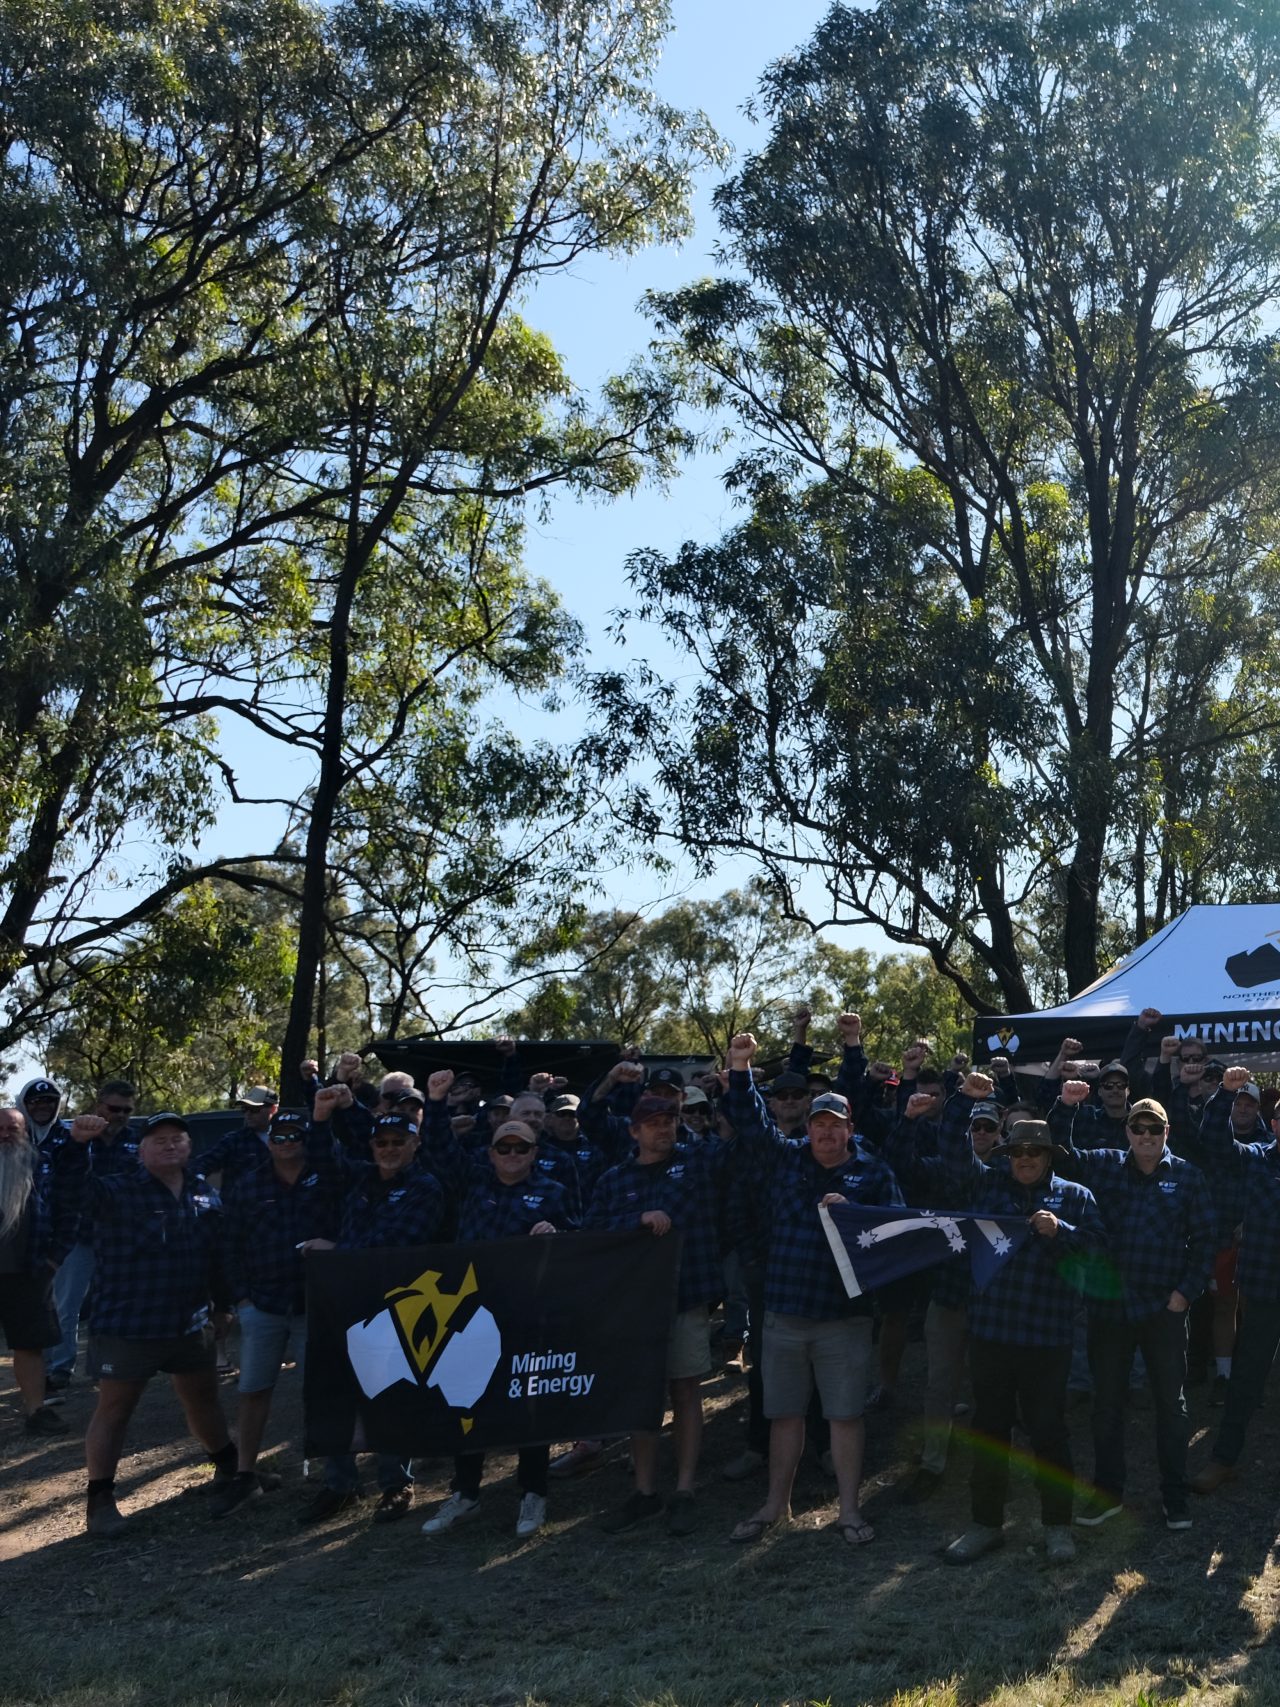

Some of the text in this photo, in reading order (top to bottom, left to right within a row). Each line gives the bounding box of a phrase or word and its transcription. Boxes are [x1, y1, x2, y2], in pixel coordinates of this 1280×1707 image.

[511, 1349, 577, 1374] Mining
[508, 1373, 596, 1399] & Energy
